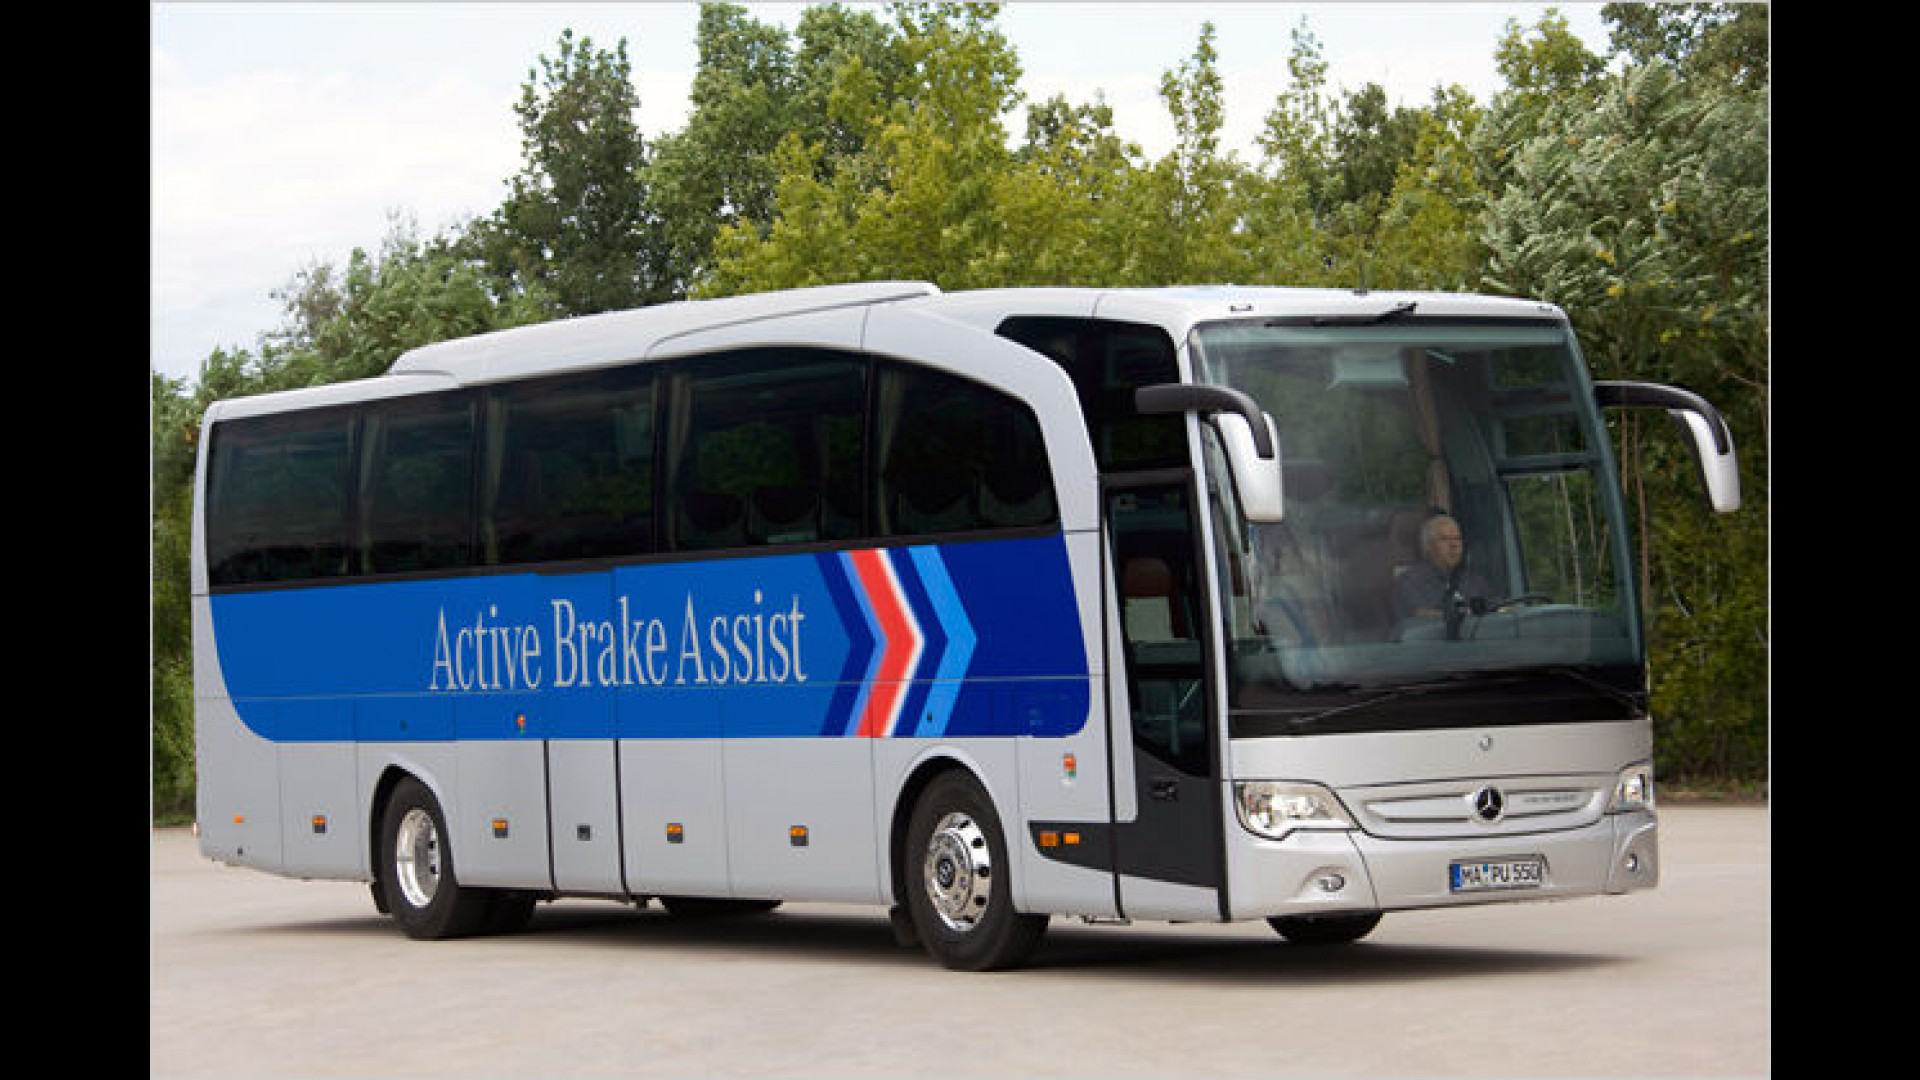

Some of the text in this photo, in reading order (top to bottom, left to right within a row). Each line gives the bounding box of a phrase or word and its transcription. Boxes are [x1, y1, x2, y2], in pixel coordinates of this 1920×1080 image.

[428, 588, 807, 690] Active Brake Assist
[1491, 865, 1510, 883] PU
